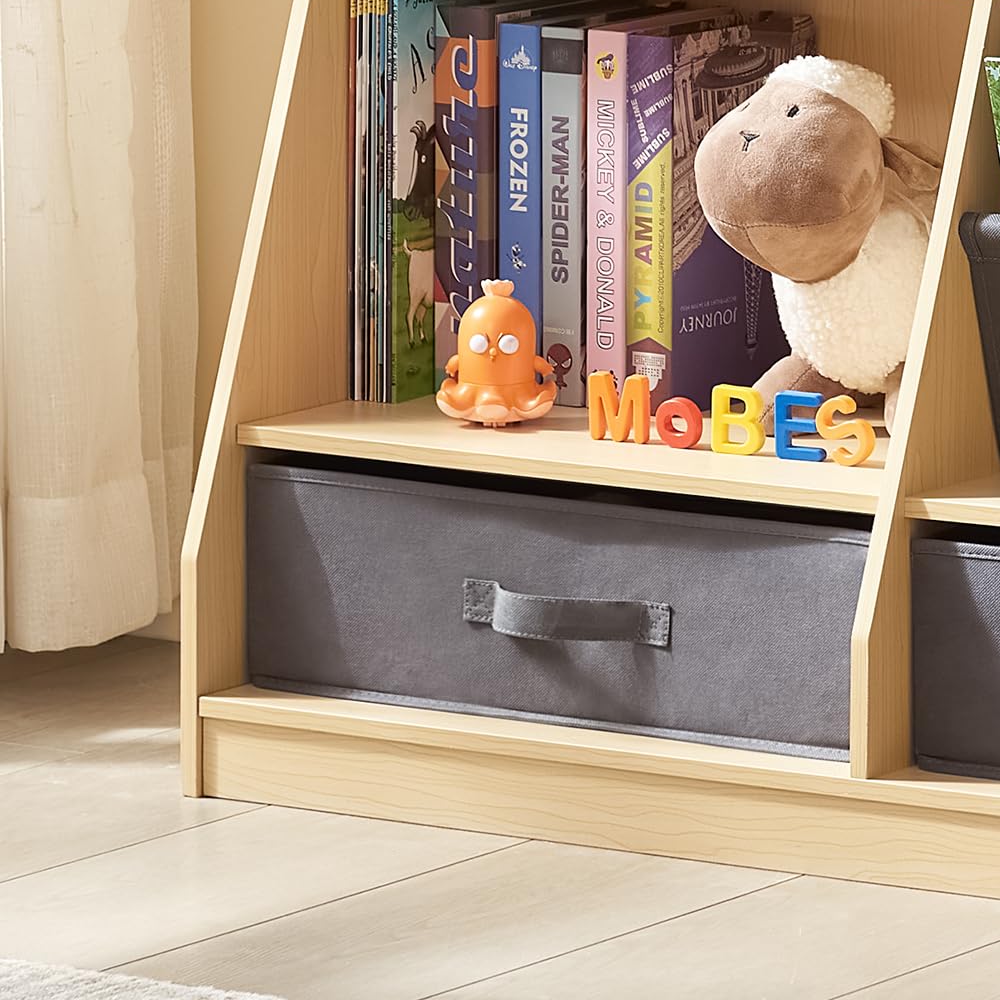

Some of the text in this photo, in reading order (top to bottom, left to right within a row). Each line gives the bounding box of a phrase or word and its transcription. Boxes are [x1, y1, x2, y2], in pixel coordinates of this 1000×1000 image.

[630, 64, 673, 94] SUBLIME
[631, 98, 649, 144] SUBLIME
[643, 93, 673, 118] SUBLIME
[510, 108, 528, 212] FROZEN
[632, 127, 670, 170] SUBLIME
[551, 116, 570, 284] SPIDER-MAN
[596, 99, 615, 350] MICKEY & DONALD
[633, 182, 653, 330] PYRAMID
[679, 307, 738, 334] JOURNEY
